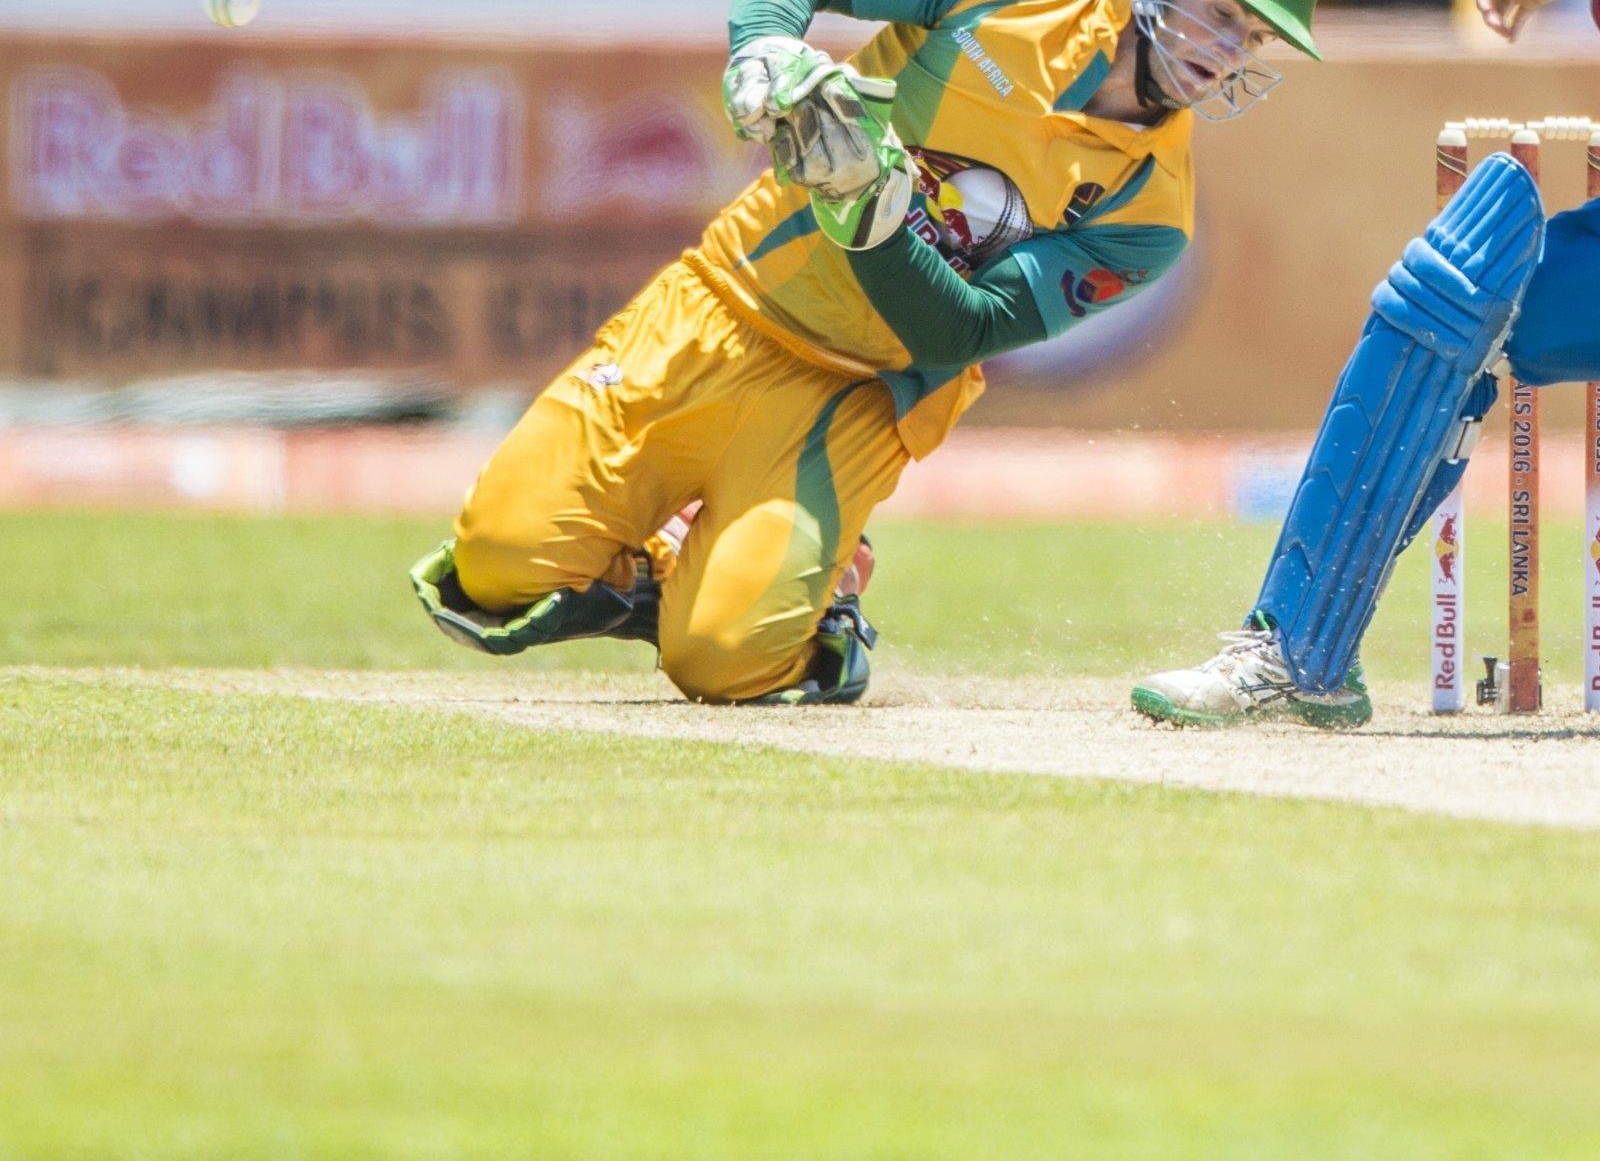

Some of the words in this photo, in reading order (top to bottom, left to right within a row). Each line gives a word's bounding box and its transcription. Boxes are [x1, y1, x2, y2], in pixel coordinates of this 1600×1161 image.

[951, 26, 985, 61] SOUTH
[976, 58, 1014, 97] AFRICA
[18, 71, 270, 221] Red
[276, 73, 520, 225] Bull
[1513, 421, 1531, 473] 2016
[1512, 490, 1530, 525] SRI
[1512, 530, 1530, 597] LANKA
[1436, 593, 1456, 639] Bull
[1436, 644, 1456, 690] Red
